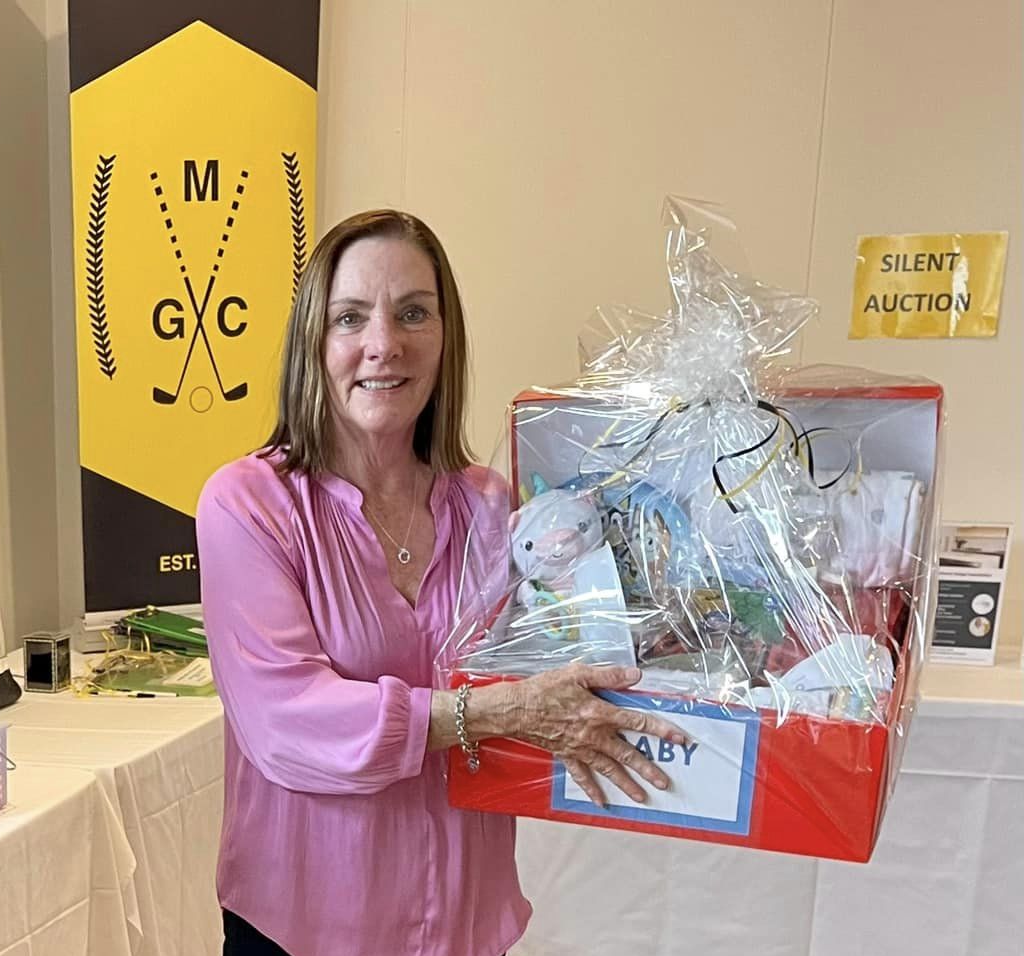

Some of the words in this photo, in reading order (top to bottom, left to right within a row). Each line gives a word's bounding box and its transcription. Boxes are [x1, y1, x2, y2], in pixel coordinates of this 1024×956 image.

[183, 159, 219, 202] M
[880, 252, 960, 273] SILENT
[863, 293, 971, 313] AUCTION
[152, 298, 185, 340] G
[217, 296, 248, 337] C
[159, 553, 197, 572] EST.
[635, 735, 699, 766] ABY
